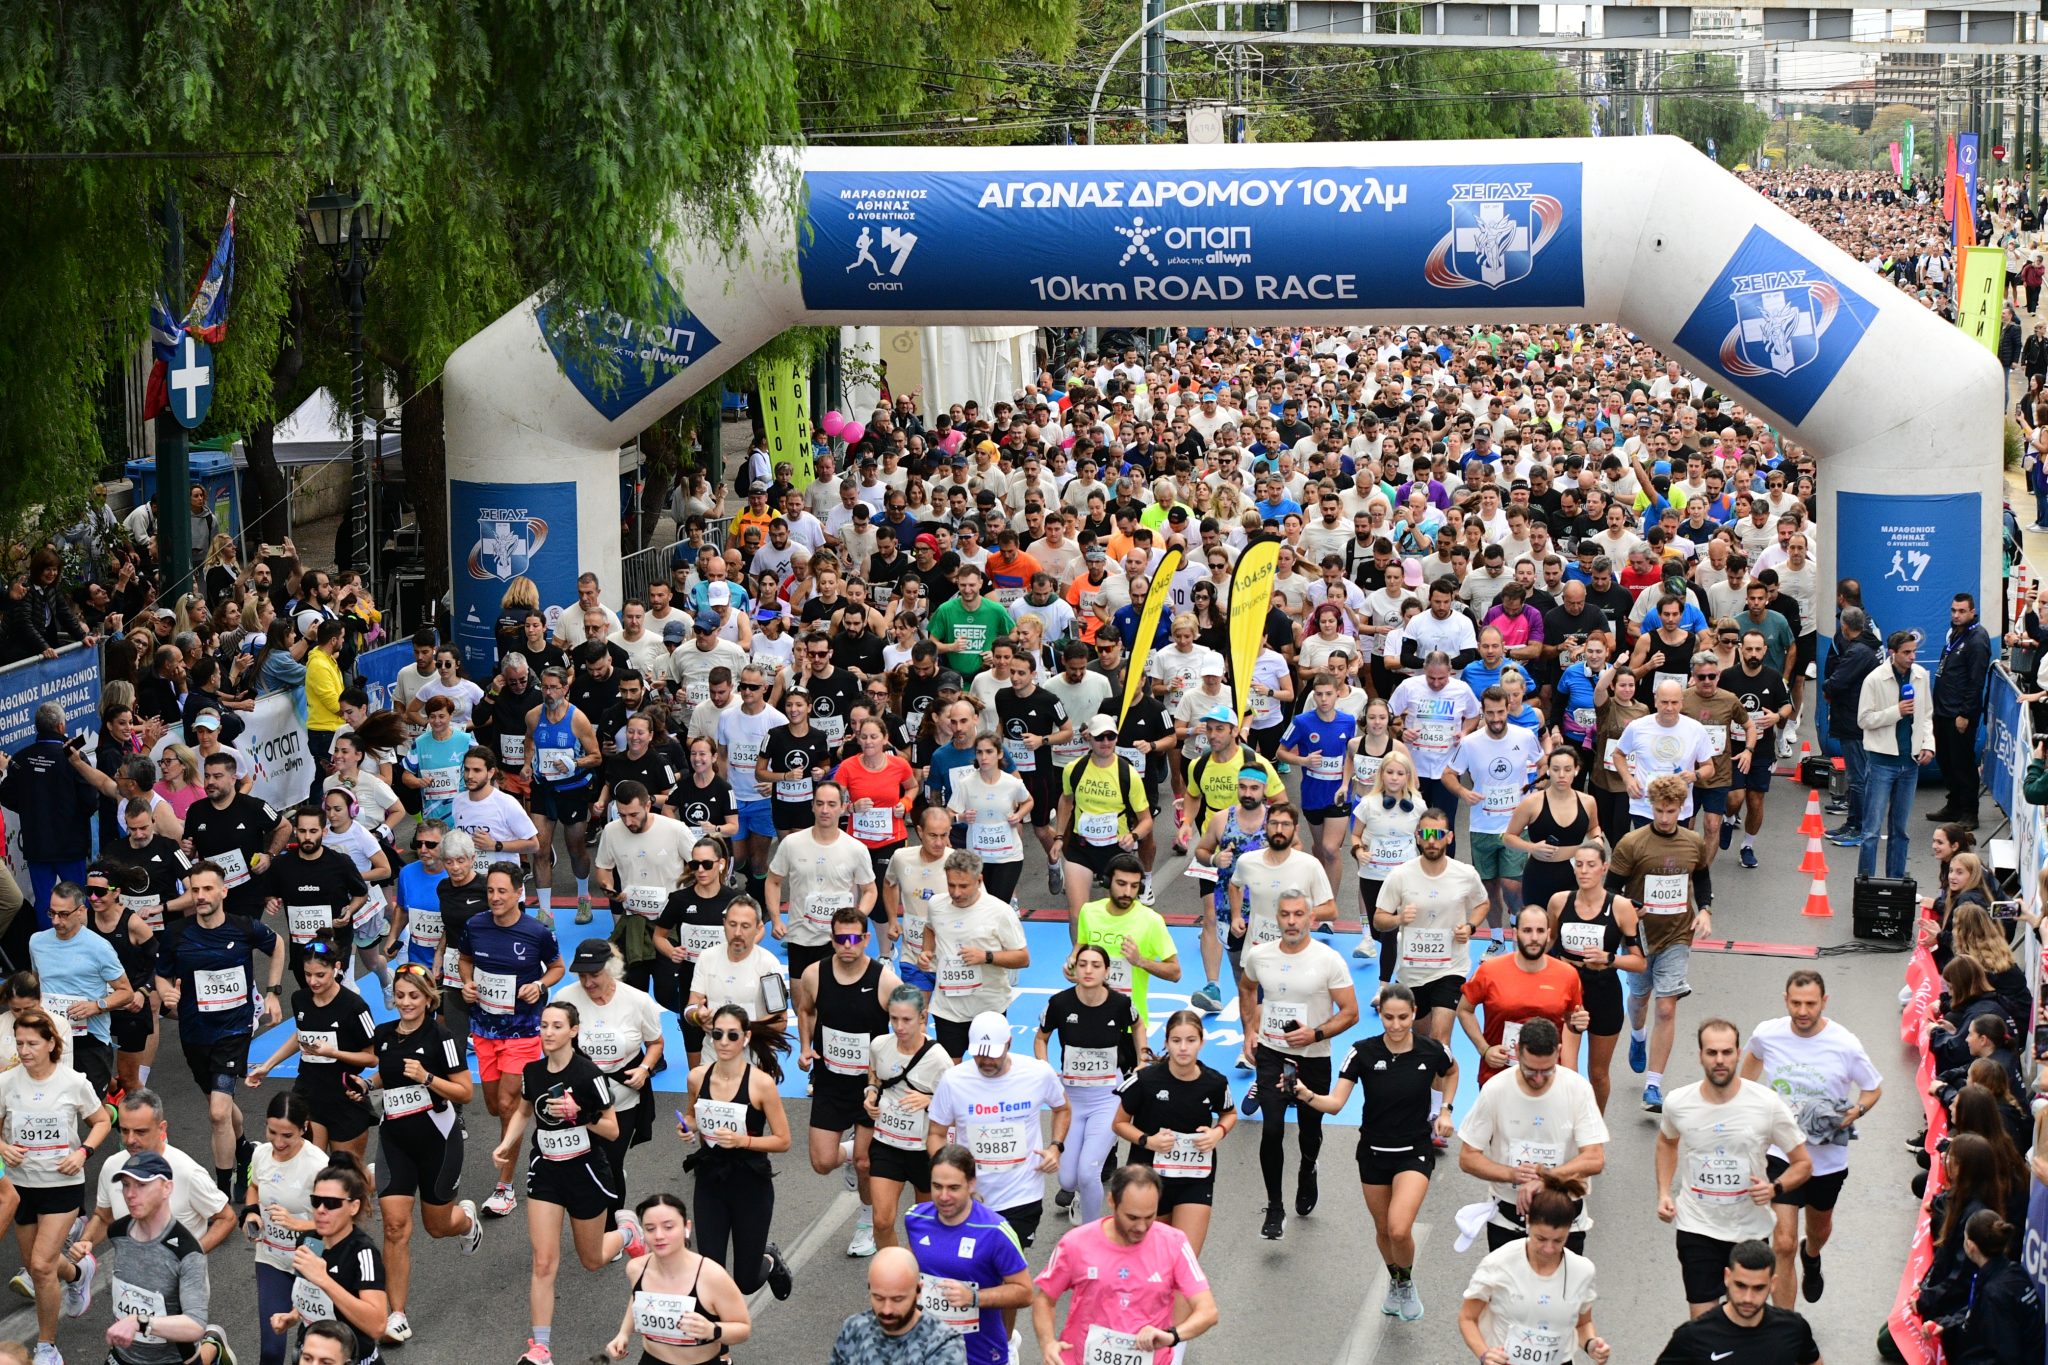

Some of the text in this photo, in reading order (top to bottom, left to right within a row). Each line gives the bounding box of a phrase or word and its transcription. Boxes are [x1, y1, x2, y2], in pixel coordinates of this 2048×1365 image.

[840, 189, 928, 199] ΜΑΡΑΘΩΝΙΟΣ
[977, 178, 1408, 213] ΑΓΩΝΑΣ ΔΡΟΜΟΥ 10χλμ
[1451, 182, 1532, 200] ΣΕΓΑΣ
[855, 200, 910, 211] ΑΘΗΝΑΣ
[857, 212, 916, 221] ΑΥΘΕΝΤΙΚΟΣ
[1167, 256, 1204, 267] μέλος της
[1205, 251, 1251, 268] allwyn
[1030, 274, 1358, 302] 10km ROAD RACE
[1732, 270, 1807, 294] ΣΕΓΑΣ
[640, 347, 690, 366] allwyn
[479, 508, 528, 520] ΣΕΓΑΣ
[1234, 562, 1273, 593] 1:04:59
[1173, 589, 1184, 605] 10
[953, 629, 987, 640] GREEK
[41, 665, 98, 697] ΜΑΡΑΘΩΝΙΟΣ
[1086, 778, 1110, 789] PACE
[1209, 776, 1232, 785] PACE
[1078, 787, 1118, 798] RUNNER
[629, 899, 660, 910] 37955
[1410, 943, 1445, 954] 39822
[943, 970, 976, 982] 38958
[203, 983, 240, 996] 39540
[827, 1044, 862, 1060] 38993
[1071, 1060, 1109, 1072] 39213
[968, 1100, 1031, 1116] #OneTeam
[881, 1112, 915, 1131] 38957
[20, 1129, 61, 1141] 39124
[543, 1134, 580, 1149] 39139
[976, 1141, 1017, 1154] 39887
[1698, 1172, 1741, 1186] 45132
[1093, 1348, 1142, 1365] 38870
[1512, 1345, 1560, 1363] 38017
